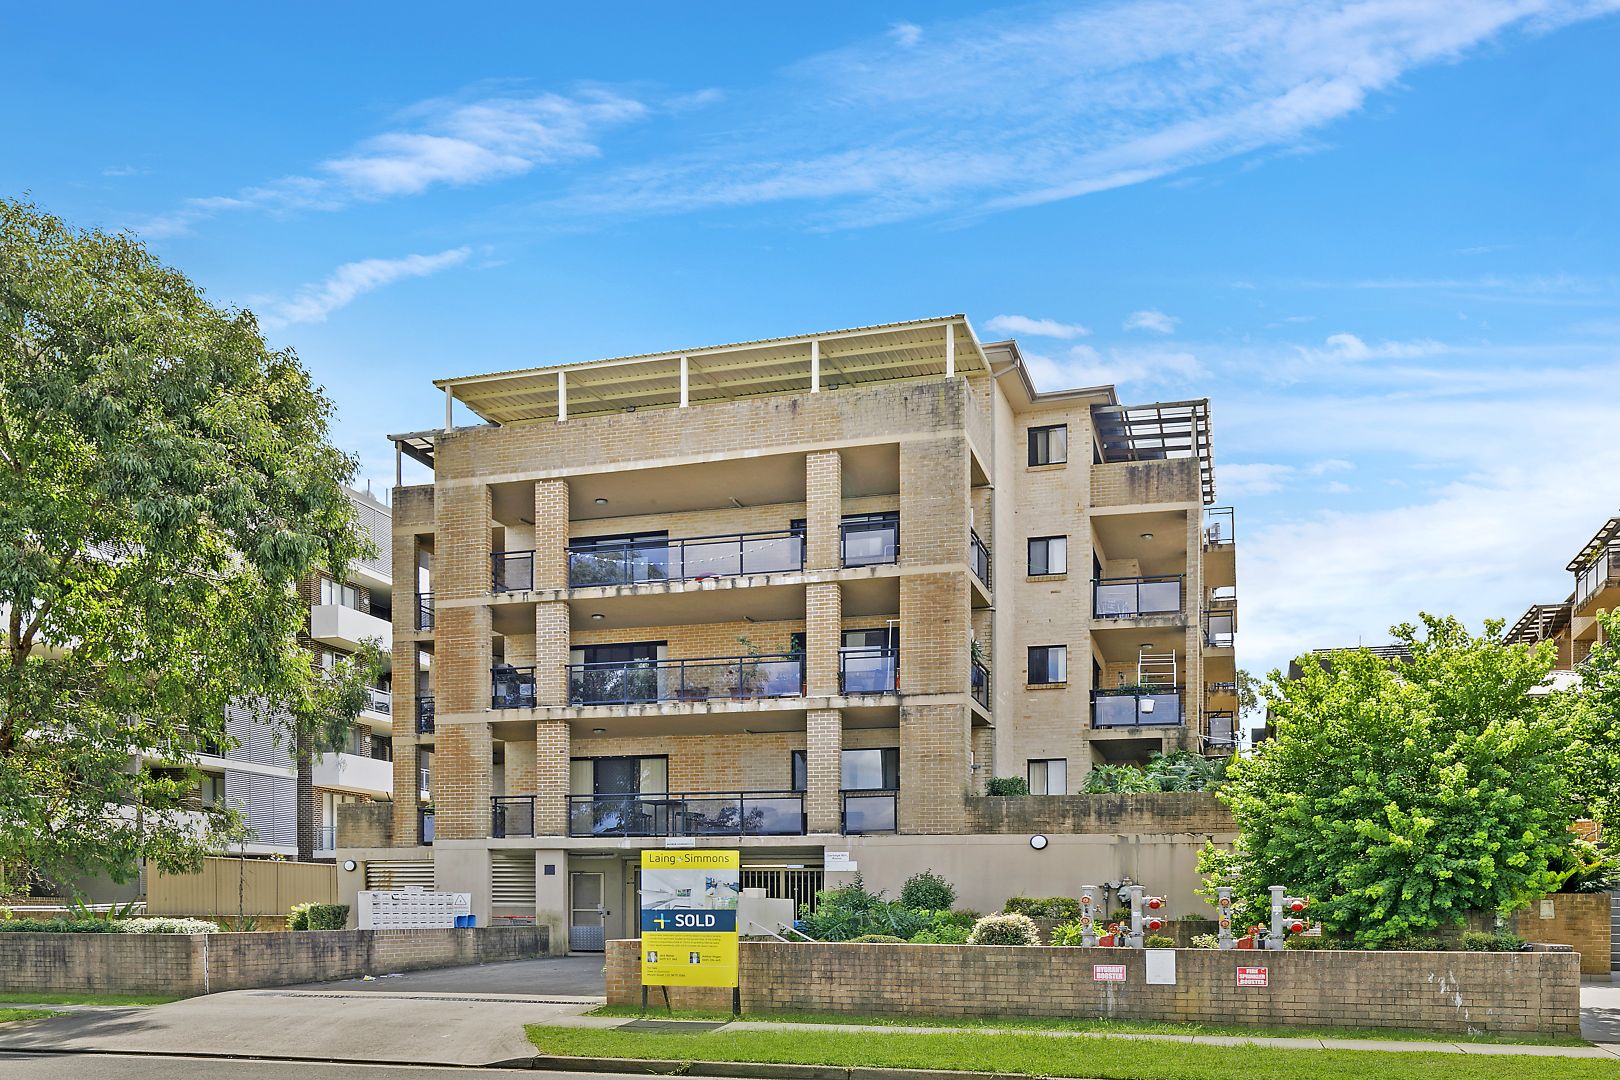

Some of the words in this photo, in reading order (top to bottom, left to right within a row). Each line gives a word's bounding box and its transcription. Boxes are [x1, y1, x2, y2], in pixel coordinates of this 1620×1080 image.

[649, 853, 676, 865] Laing
[684, 853, 730, 863] Simmons
[675, 914, 716, 927] SOLD
